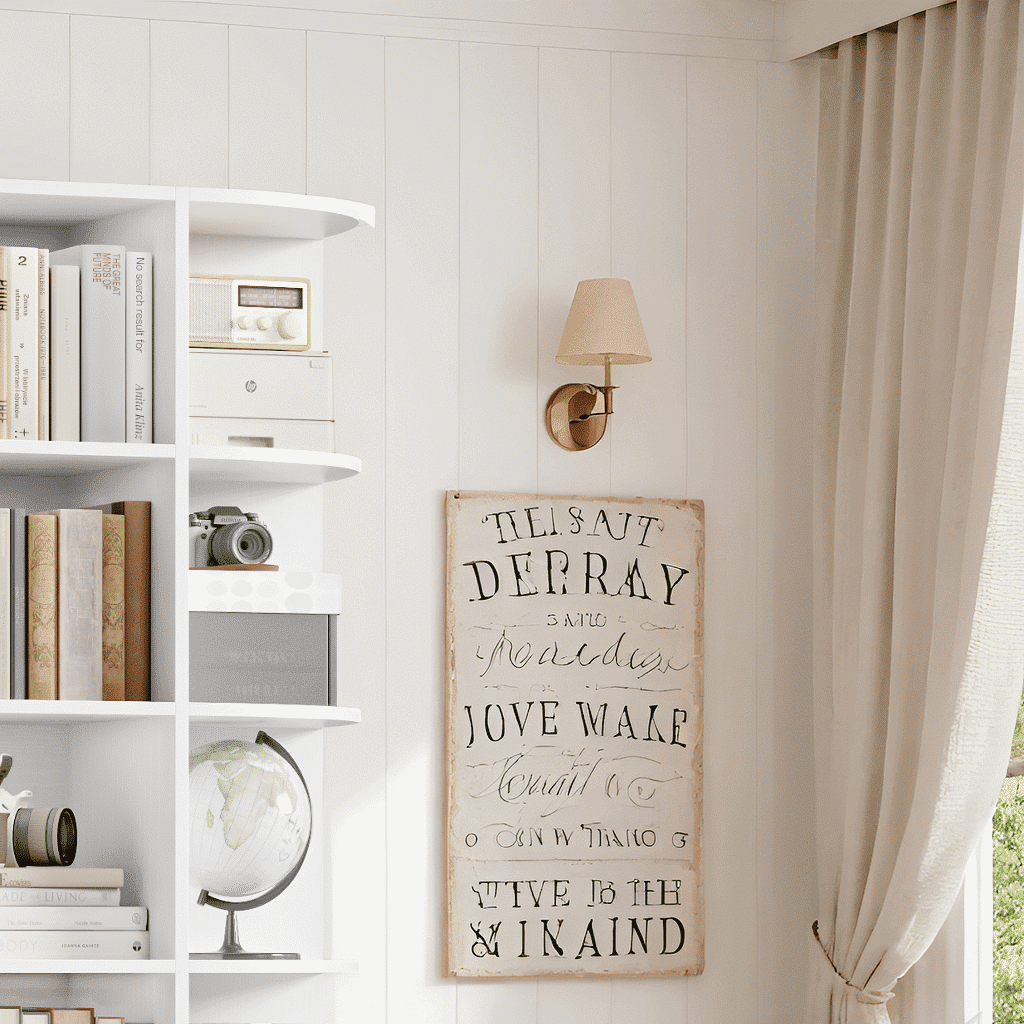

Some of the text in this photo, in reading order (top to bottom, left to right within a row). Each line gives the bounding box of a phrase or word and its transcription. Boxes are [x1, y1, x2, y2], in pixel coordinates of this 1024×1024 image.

[18, 255, 27, 266] 2
[92, 252, 102, 283] FUTURE
[102, 252, 112, 290] MINDS OF
[112, 253, 121, 296] THE GREAT
[135, 257, 145, 353] No search result for
[245, 380, 258, 394] hp
[134, 384, 146, 440] Anita Klinz
[44, 891, 87, 902] LIVING
